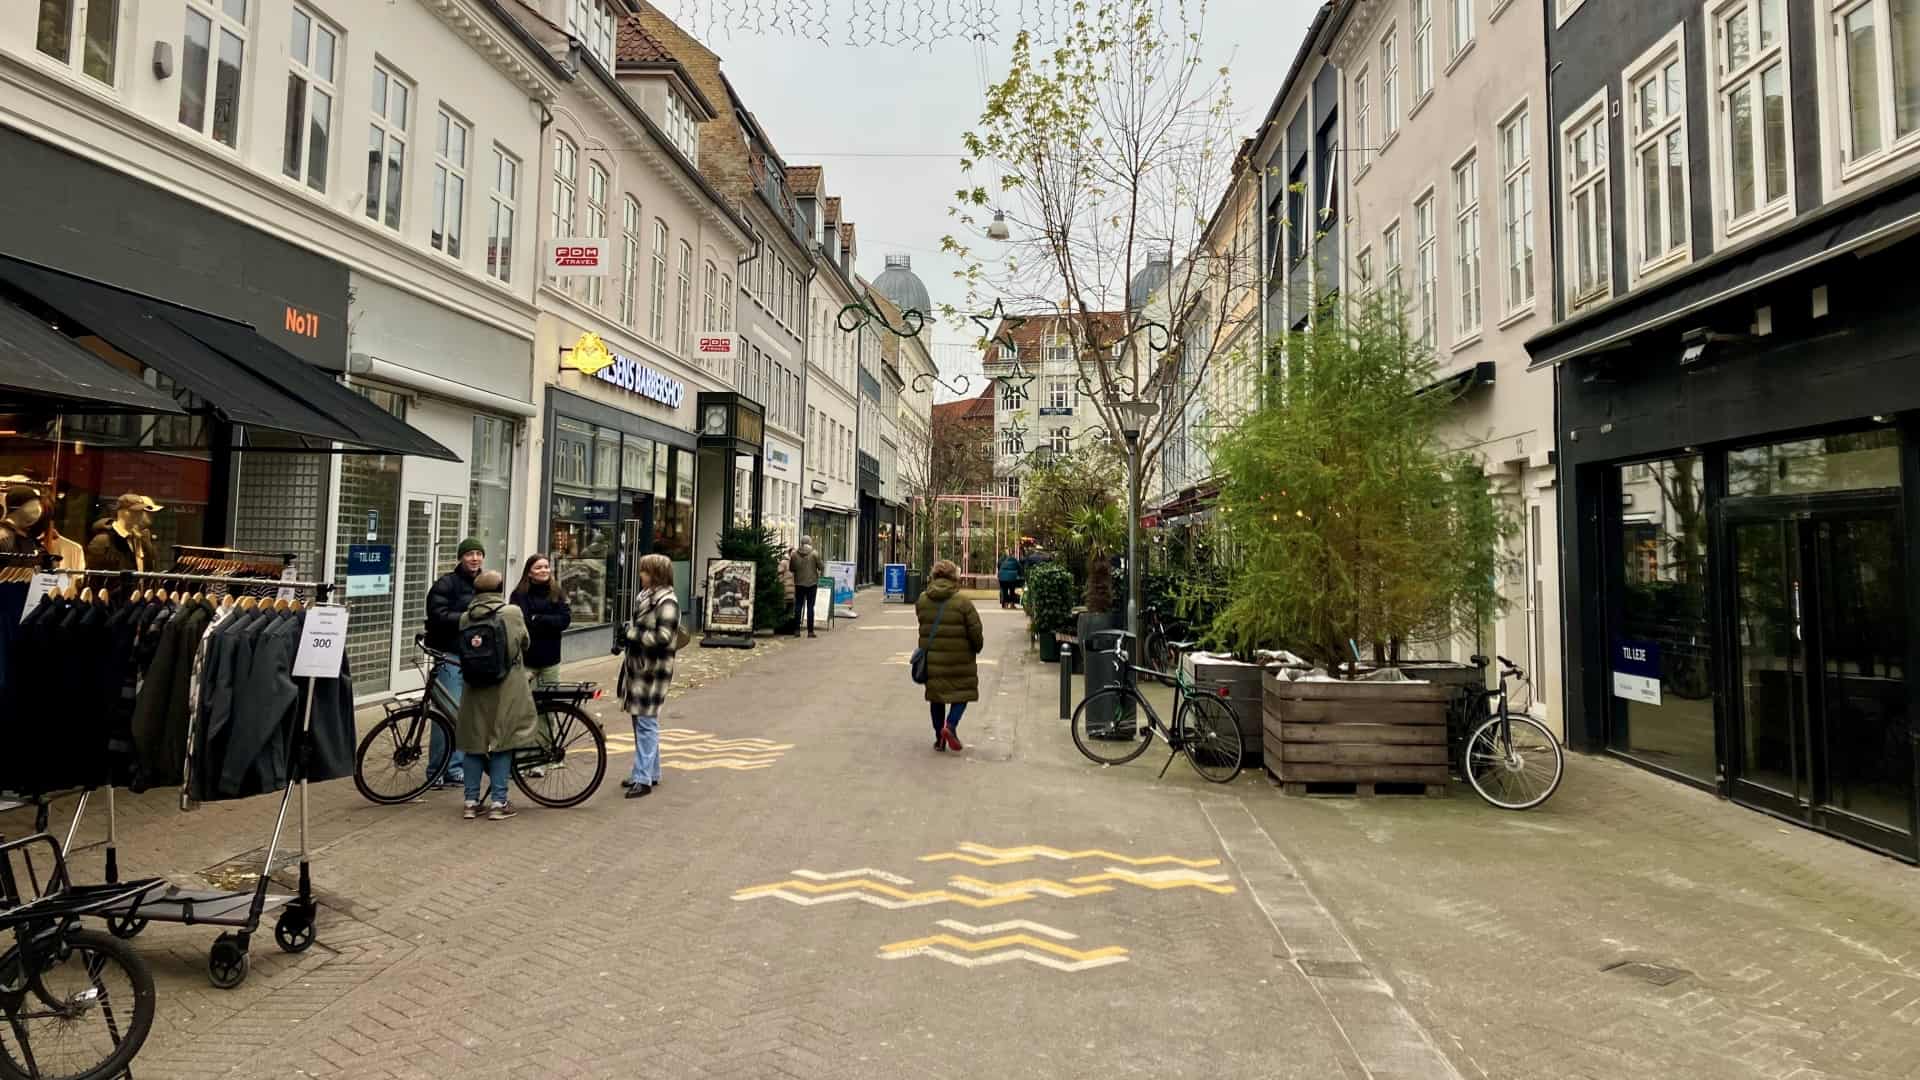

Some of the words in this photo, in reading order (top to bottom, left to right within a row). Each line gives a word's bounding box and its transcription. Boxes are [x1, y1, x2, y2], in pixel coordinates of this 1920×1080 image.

[556, 248, 597, 256] FDM
[286, 306, 318, 338] No11
[634, 362, 684, 408] BARBERSHOP
[312, 638, 332, 648] 300
[1622, 646, 1632, 660] TIL
